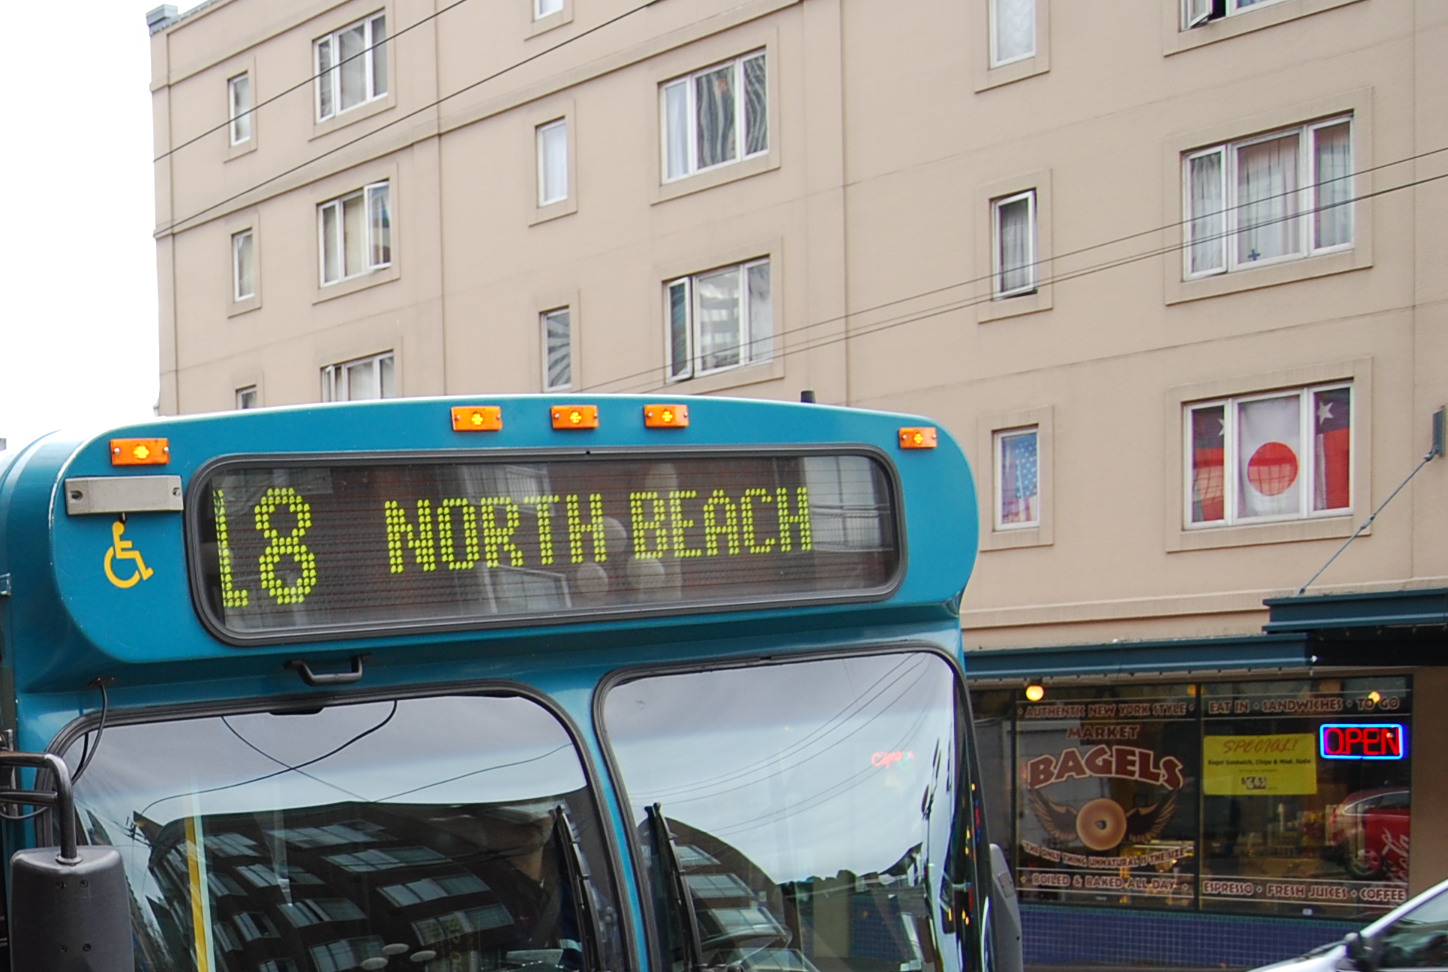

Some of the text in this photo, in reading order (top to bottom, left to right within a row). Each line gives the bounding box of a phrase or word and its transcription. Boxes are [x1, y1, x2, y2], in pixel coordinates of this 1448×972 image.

[384, 494, 607, 574] NORTH
[630, 486, 812, 560] BEACH
[1025, 702, 1186, 718] AUTHENTIC NEW YORK STYLE
[1208, 696, 1400, 714] EAT IN SANDWICHES TO GO
[1067, 725, 1140, 740] MARKET
[1323, 727, 1401, 756] OPEN
[1027, 744, 1183, 790] BAGELS
[1062, 852, 1087, 867] THING
[1032, 873, 1176, 890] BOILED & BAKED ALL DAY
[1203, 881, 1406, 902] ESPRESSO FRESH JUICES COFFEE
